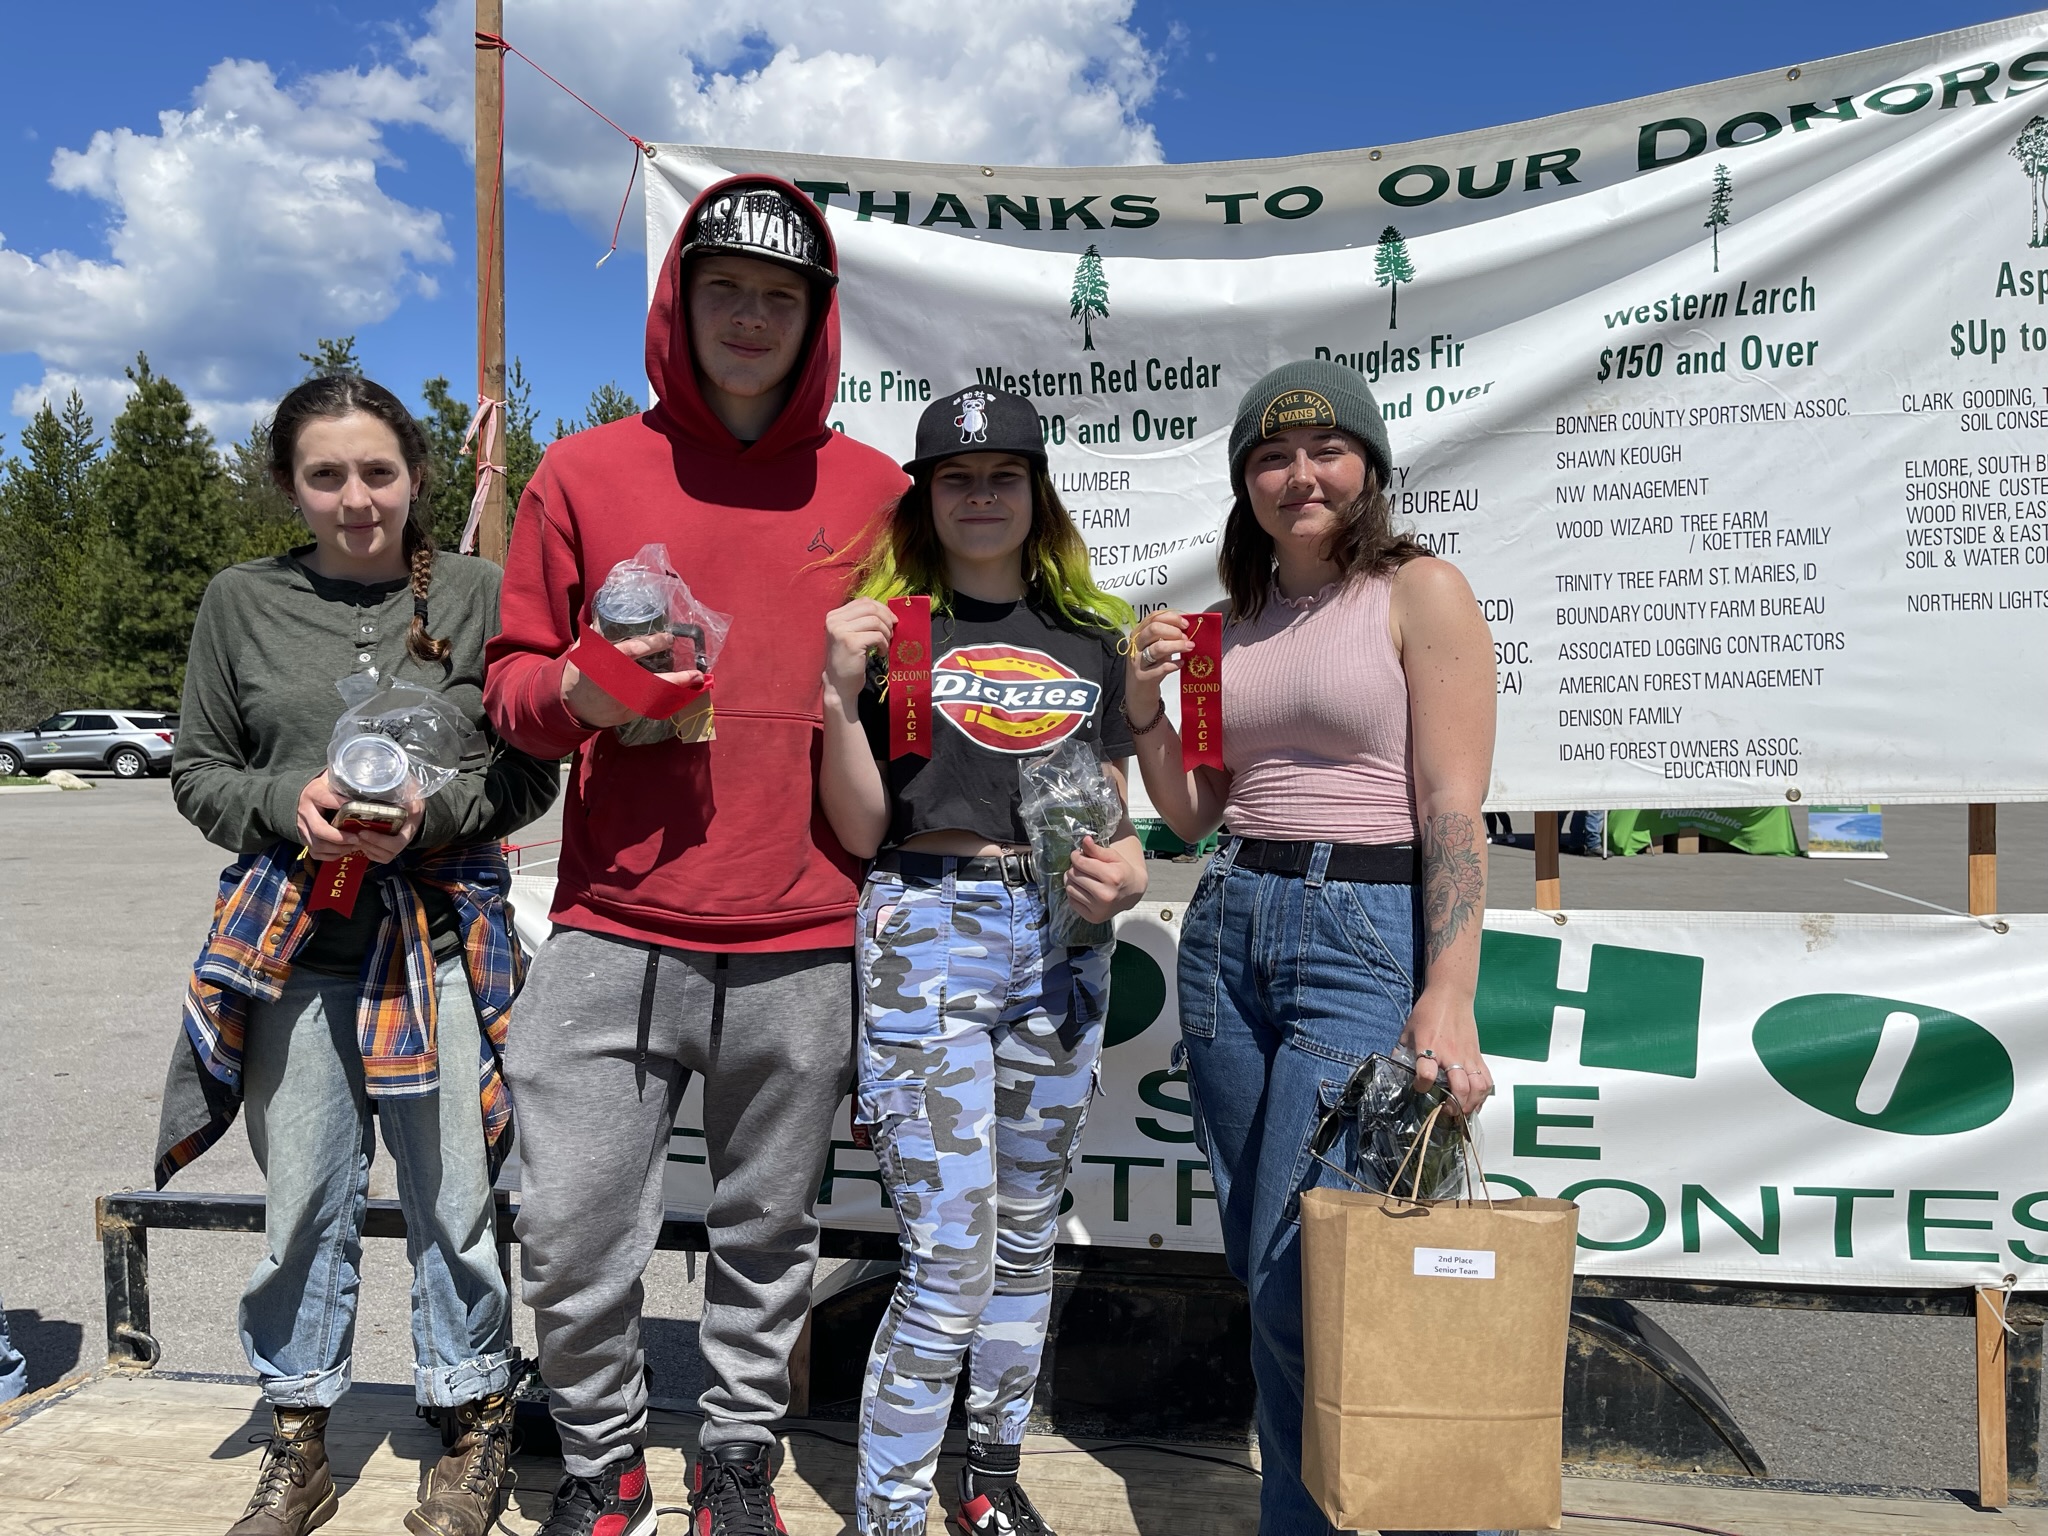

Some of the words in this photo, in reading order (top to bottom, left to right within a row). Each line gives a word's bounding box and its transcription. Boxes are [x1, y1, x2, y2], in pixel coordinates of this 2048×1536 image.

[794, 178, 1160, 231] THANKS
[1205, 184, 1324, 225] TO
[1378, 147, 1582, 207] OUR
[1637, 49, 2048, 172] DONORS
[1734, 275, 1816, 317] Larch
[1431, 334, 1465, 369] Fir
[1950, 318, 2006, 364] $Up
[2019, 322, 2048, 352] to
[1596, 342, 1664, 385] $150
[1676, 341, 1726, 376] and
[1741, 334, 1819, 371] Over
[834, 371, 872, 403] ite
[880, 370, 931, 402] Pine
[976, 367, 1082, 401] Western
[1090, 359, 1138, 395] Red
[1145, 356, 1222, 392] Cedar
[1266, 407, 1279, 429] OFF
[1277, 394, 1300, 408] THE
[1304, 394, 1330, 419] WALL
[1383, 393, 1412, 421] nd
[1426, 380, 1496, 412] Over
[1902, 391, 1954, 413] CLARK
[1962, 387, 2036, 410] GOODING,
[1078, 414, 1121, 445] and
[1132, 408, 1198, 441] Over
[1282, 409, 1313, 421] VANS
[1555, 413, 1618, 436] BONNER
[1622, 407, 1686, 431] COUNTY
[1688, 401, 1786, 427] SPORTSMEN
[1793, 397, 1851, 419] ASSOC.
[1960, 412, 1994, 432] SOIL
[1556, 448, 1616, 470] SHAWN
[1620, 444, 1682, 466] KEOUGH
[1905, 457, 1973, 479] ELMORE,
[1977, 454, 2030, 475] SOUTH
[1062, 471, 1130, 492] LUMBER
[1556, 484, 1586, 504] NW
[1593, 477, 1710, 502] MANAGEMENT
[1905, 479, 1991, 502] SHOSHONE
[2000, 478, 2048, 497] CUSTE
[1402, 488, 1479, 515] BUREAU
[1905, 504, 1956, 525] WOOD
[1962, 502, 2011, 523] RIVER,
[1082, 508, 1130, 529] FARM
[1555, 519, 1604, 540] WOOD
[1610, 515, 1673, 537] WIZARD
[1679, 513, 1719, 533] TREE
[1722, 510, 1768, 531] FARM
[1416, 533, 1462, 555] GMT.
[1702, 529, 1772, 551] KOETTER
[1776, 526, 1832, 548] FAMILY
[1906, 525, 1987, 547] WESTSIDE
[1992, 524, 2006, 544] &
[1089, 545, 1131, 566] REST
[1132, 538, 1189, 563] MGMT.
[1905, 550, 1939, 570] SOIL
[1943, 549, 1957, 568] &
[1963, 547, 2020, 567] WATER
[1097, 564, 1169, 592] RODUCTS
[1554, 572, 1613, 593] TRINITY
[1616, 570, 1655, 590] TREE
[1658, 568, 1703, 588] FARM
[1708, 566, 1730, 586] ST.
[1734, 563, 1800, 585] MARIES,
[1803, 562, 1817, 581] ID
[1556, 604, 1641, 626] BOUNDARY
[1643, 601, 1707, 622] COUNTY
[1710, 599, 1755, 619] FARM
[1760, 596, 1825, 617] BUREAU
[1907, 591, 1993, 613] NORTHERN
[1494, 641, 1533, 665] SOC.
[1558, 639, 1651, 661] ASSOCIATED
[1656, 636, 1722, 657] LOGGING
[1727, 631, 1845, 655] CONTRACTORS
[891, 670, 930, 682] SECOND
[1182, 683, 1220, 693] SECOND
[1558, 674, 1639, 695] AMERICAN
[1644, 672, 1702, 692] FOREST
[1704, 667, 1825, 690] MANAGEMENT
[932, 674, 1089, 707] Dickies
[906, 686, 917, 741] PLACE
[1197, 697, 1208, 752] PLACE
[1559, 707, 1623, 728] DENISON
[1629, 706, 1683, 726] FAMILY
[1559, 742, 1605, 762] IDAHO
[1609, 741, 1668, 761] FOREST
[1670, 738, 1739, 759] OWNERS
[1745, 737, 1802, 757] ASSOC.
[1664, 759, 1751, 780] EDUCATION
[1756, 758, 1798, 778] FUND
[330, 856, 353, 898] PLACE
[1483, 1173, 2048, 1264] ONTE
[1434, 1266, 1458, 1274] Senior
